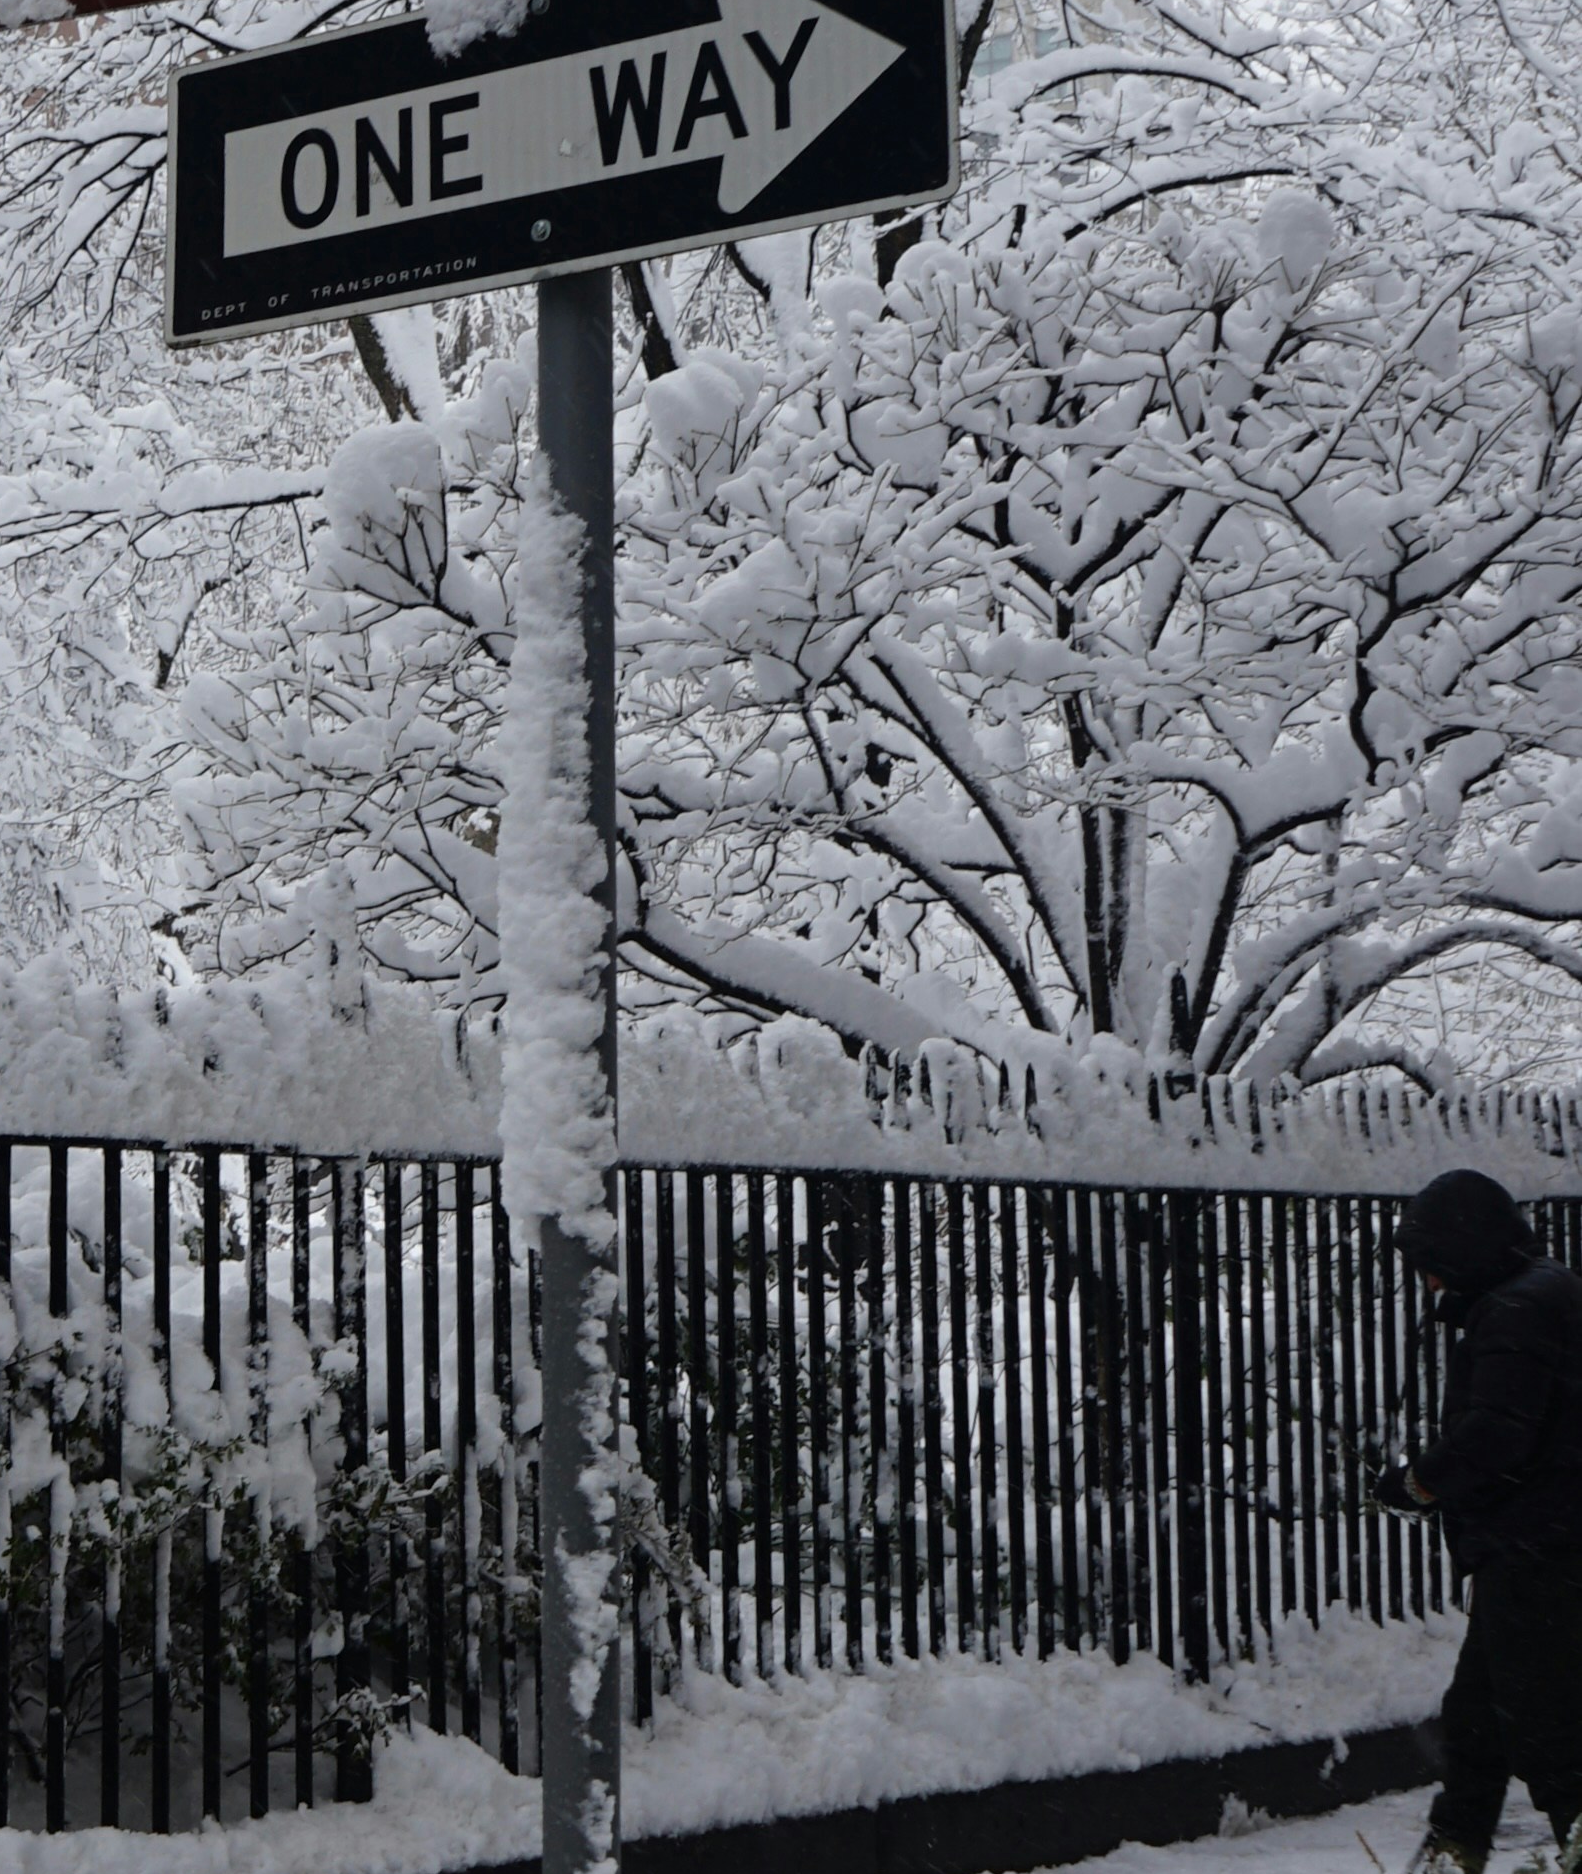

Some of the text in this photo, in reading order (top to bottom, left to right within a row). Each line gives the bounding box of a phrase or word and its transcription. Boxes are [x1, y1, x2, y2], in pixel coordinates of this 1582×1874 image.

[280, 15, 820, 231] ONE WAY
[200, 255, 478, 322] DEPT OF TRANSPORTATION
